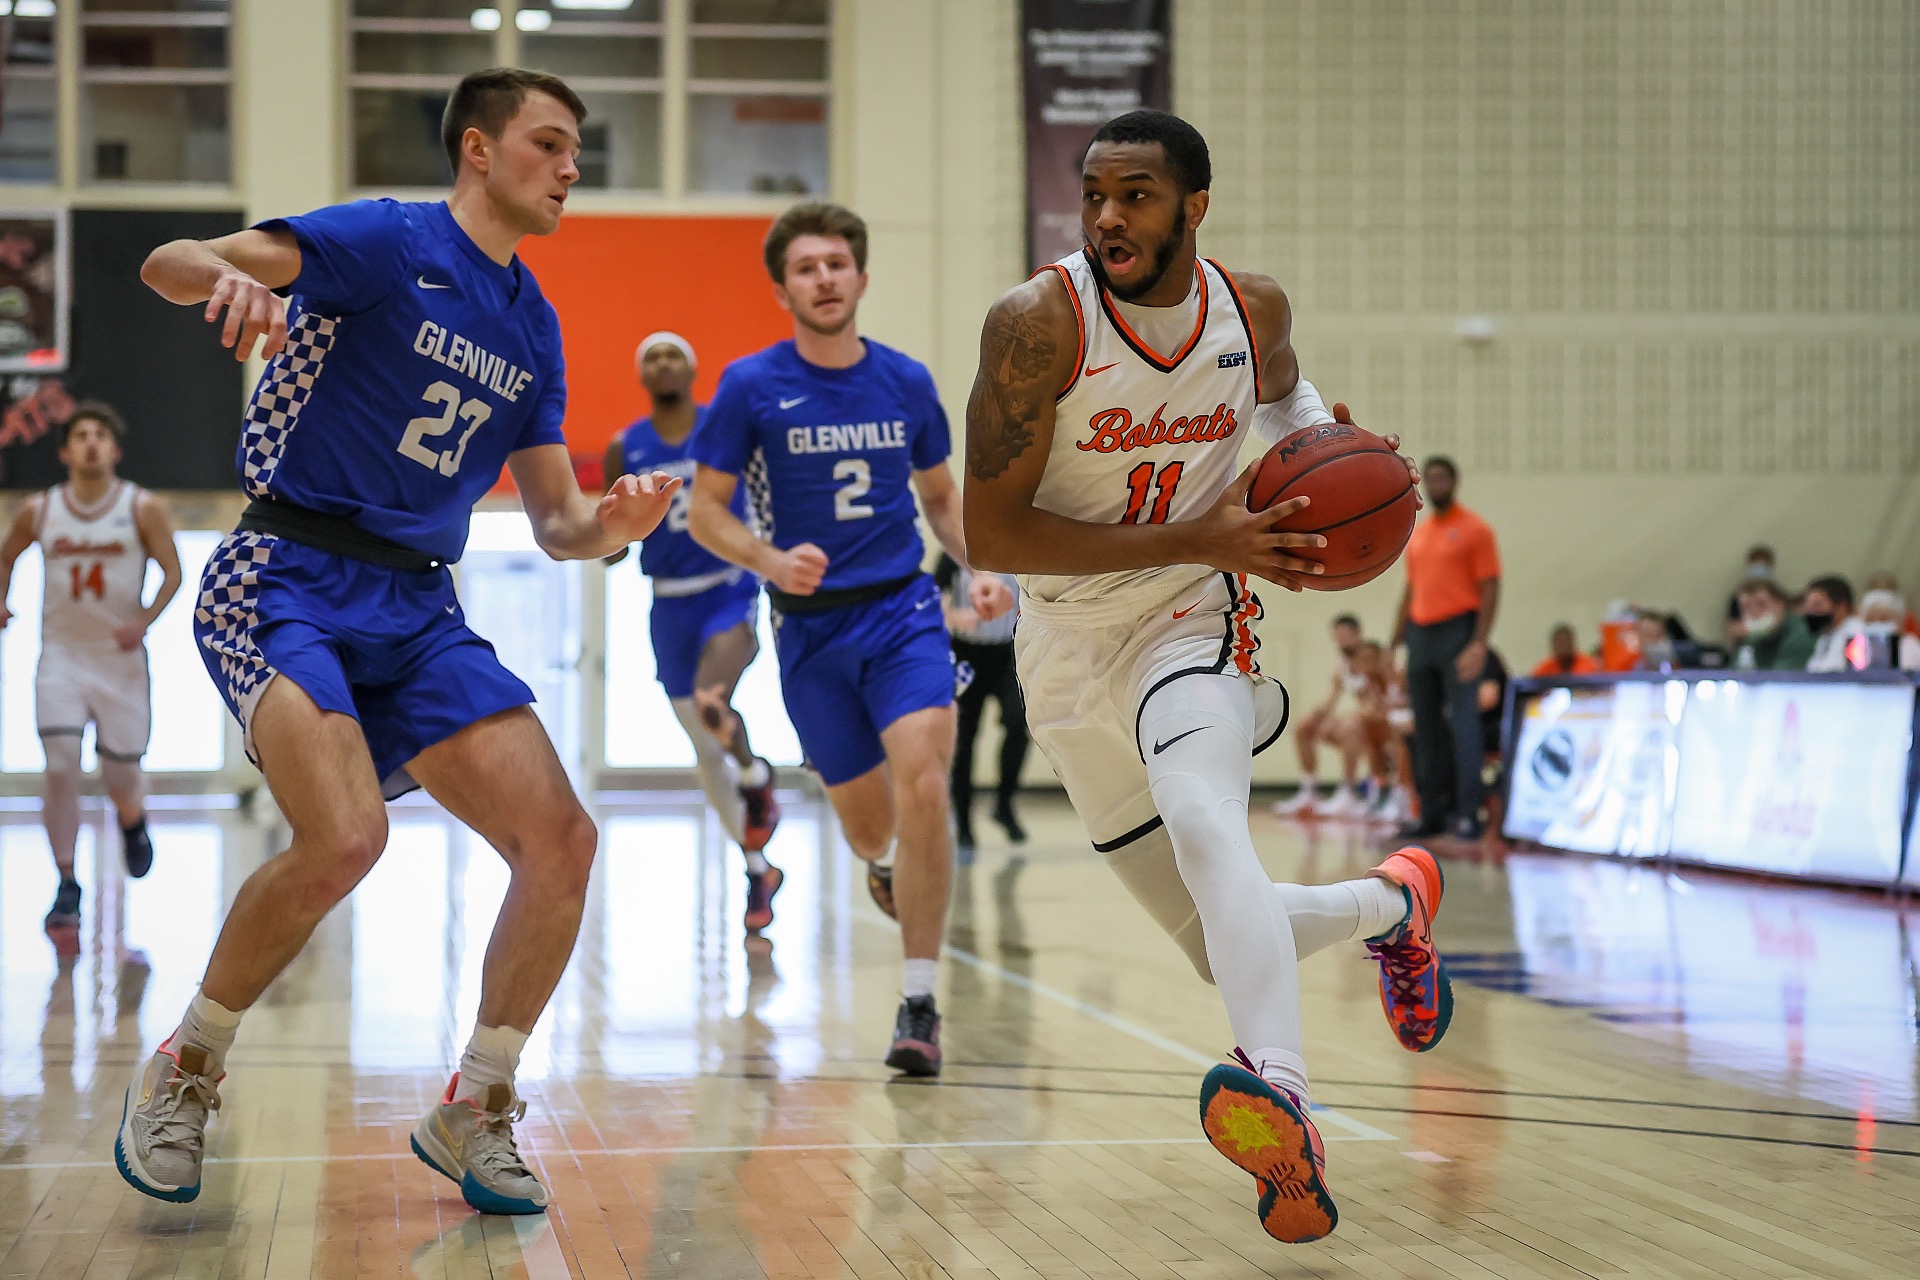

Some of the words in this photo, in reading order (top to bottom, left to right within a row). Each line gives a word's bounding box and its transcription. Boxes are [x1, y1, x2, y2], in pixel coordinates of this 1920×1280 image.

[413, 319, 534, 403] GLENVILLE
[1217, 357, 1246, 369] EAST
[396, 380, 493, 478] 23
[787, 420, 906, 455] GLENVILLE
[1076, 401, 1238, 453] Bobcats
[1279, 426, 1356, 465] NCAA
[832, 458, 875, 521] 2
[1118, 460, 1186, 525] 11
[70, 562, 105, 600] 14
